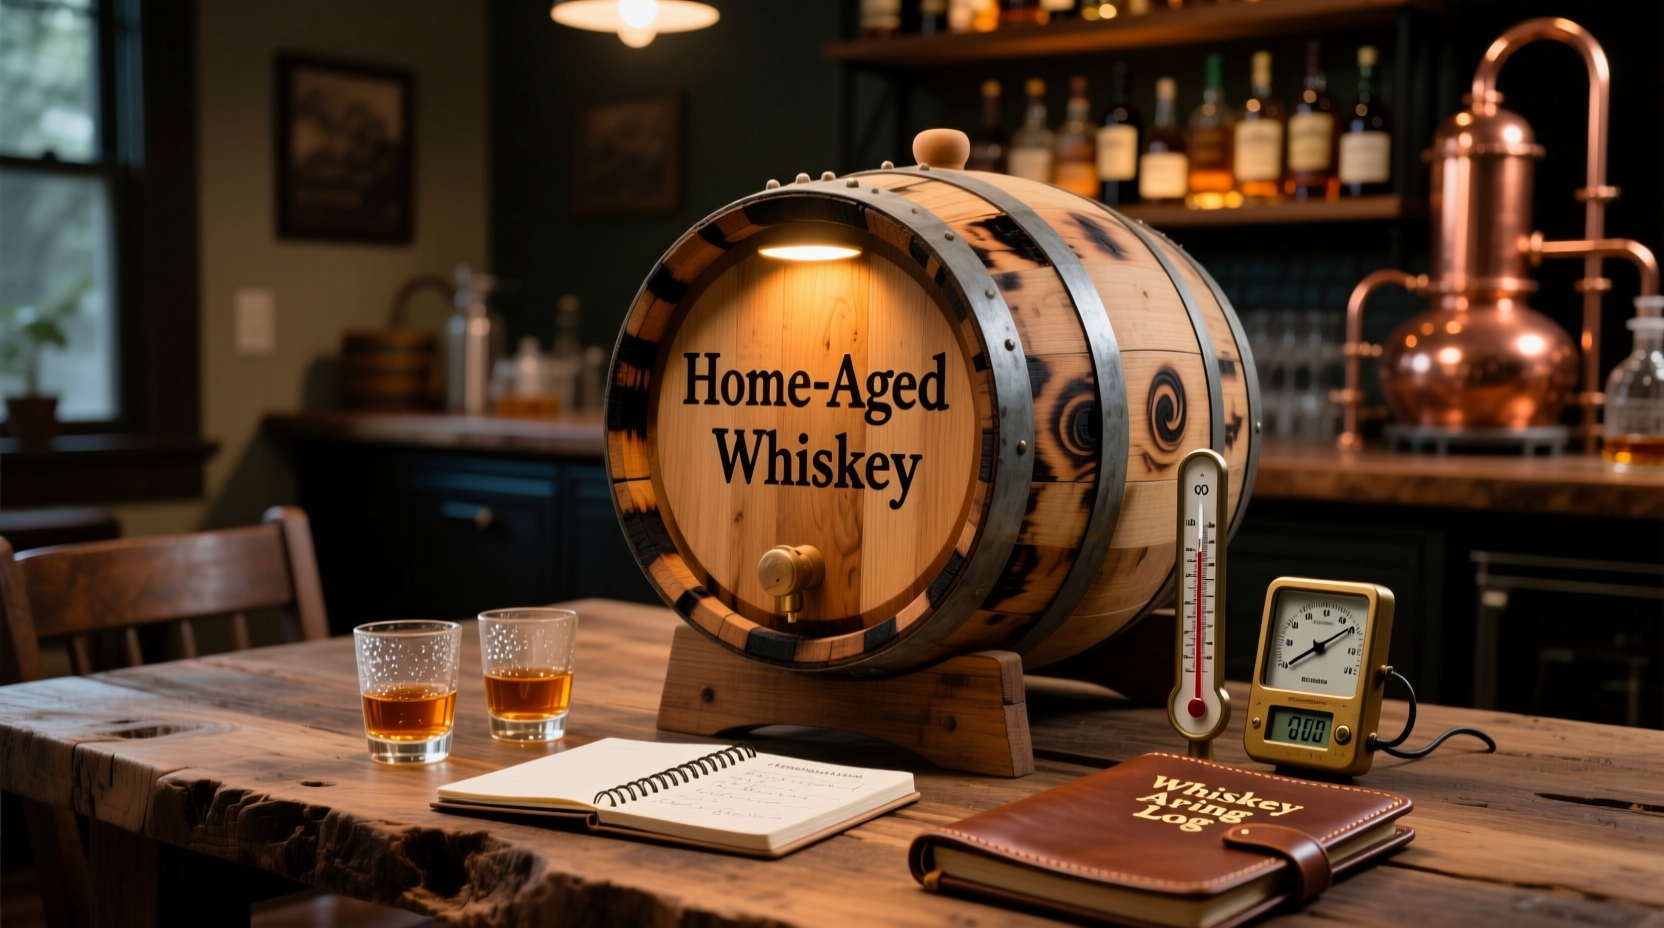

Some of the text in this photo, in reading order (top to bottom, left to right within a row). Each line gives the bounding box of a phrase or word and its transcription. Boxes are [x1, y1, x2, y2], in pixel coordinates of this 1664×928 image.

[683, 352, 950, 426] Home-Aged
[712, 428, 923, 510] Whiskey
[1132, 805, 1215, 832] Log
[1153, 775, 1304, 816] Whiskey
